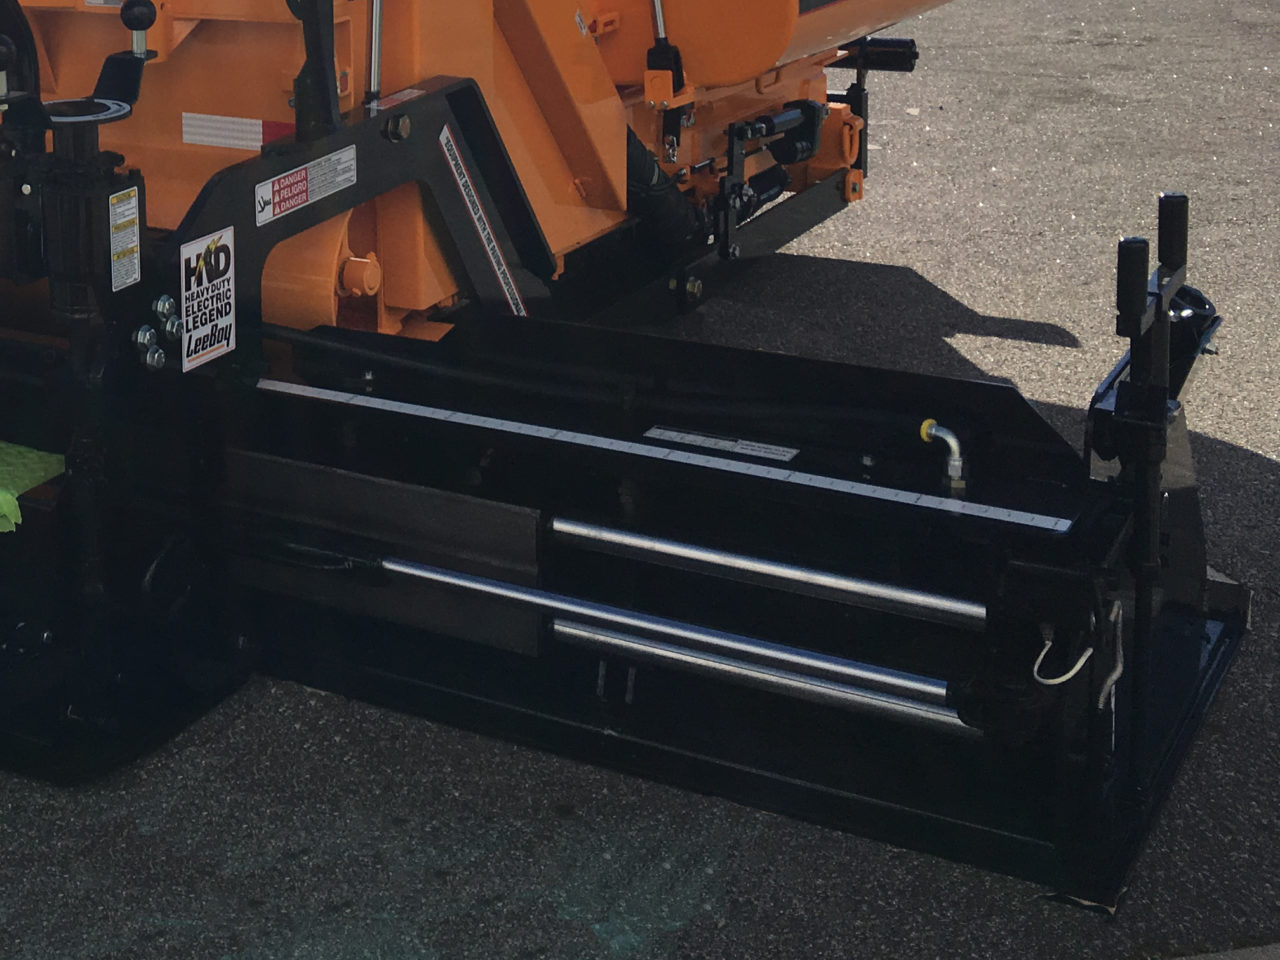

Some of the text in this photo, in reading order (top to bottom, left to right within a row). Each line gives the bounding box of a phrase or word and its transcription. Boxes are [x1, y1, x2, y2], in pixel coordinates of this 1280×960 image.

[280, 169, 306, 188] DANGER
[280, 181, 307, 200] PELIGRO
[280, 193, 307, 211] DANGER
[461, 178, 480, 217] DESIGNED
[476, 212, 488, 234] WITH
[483, 229, 494, 247] THE
[185, 277, 231, 305] HEAVY DUTY
[185, 288, 232, 318] ELECTRIC
[185, 301, 232, 334] LEGEND
[186, 323, 233, 358] LeeBoy
